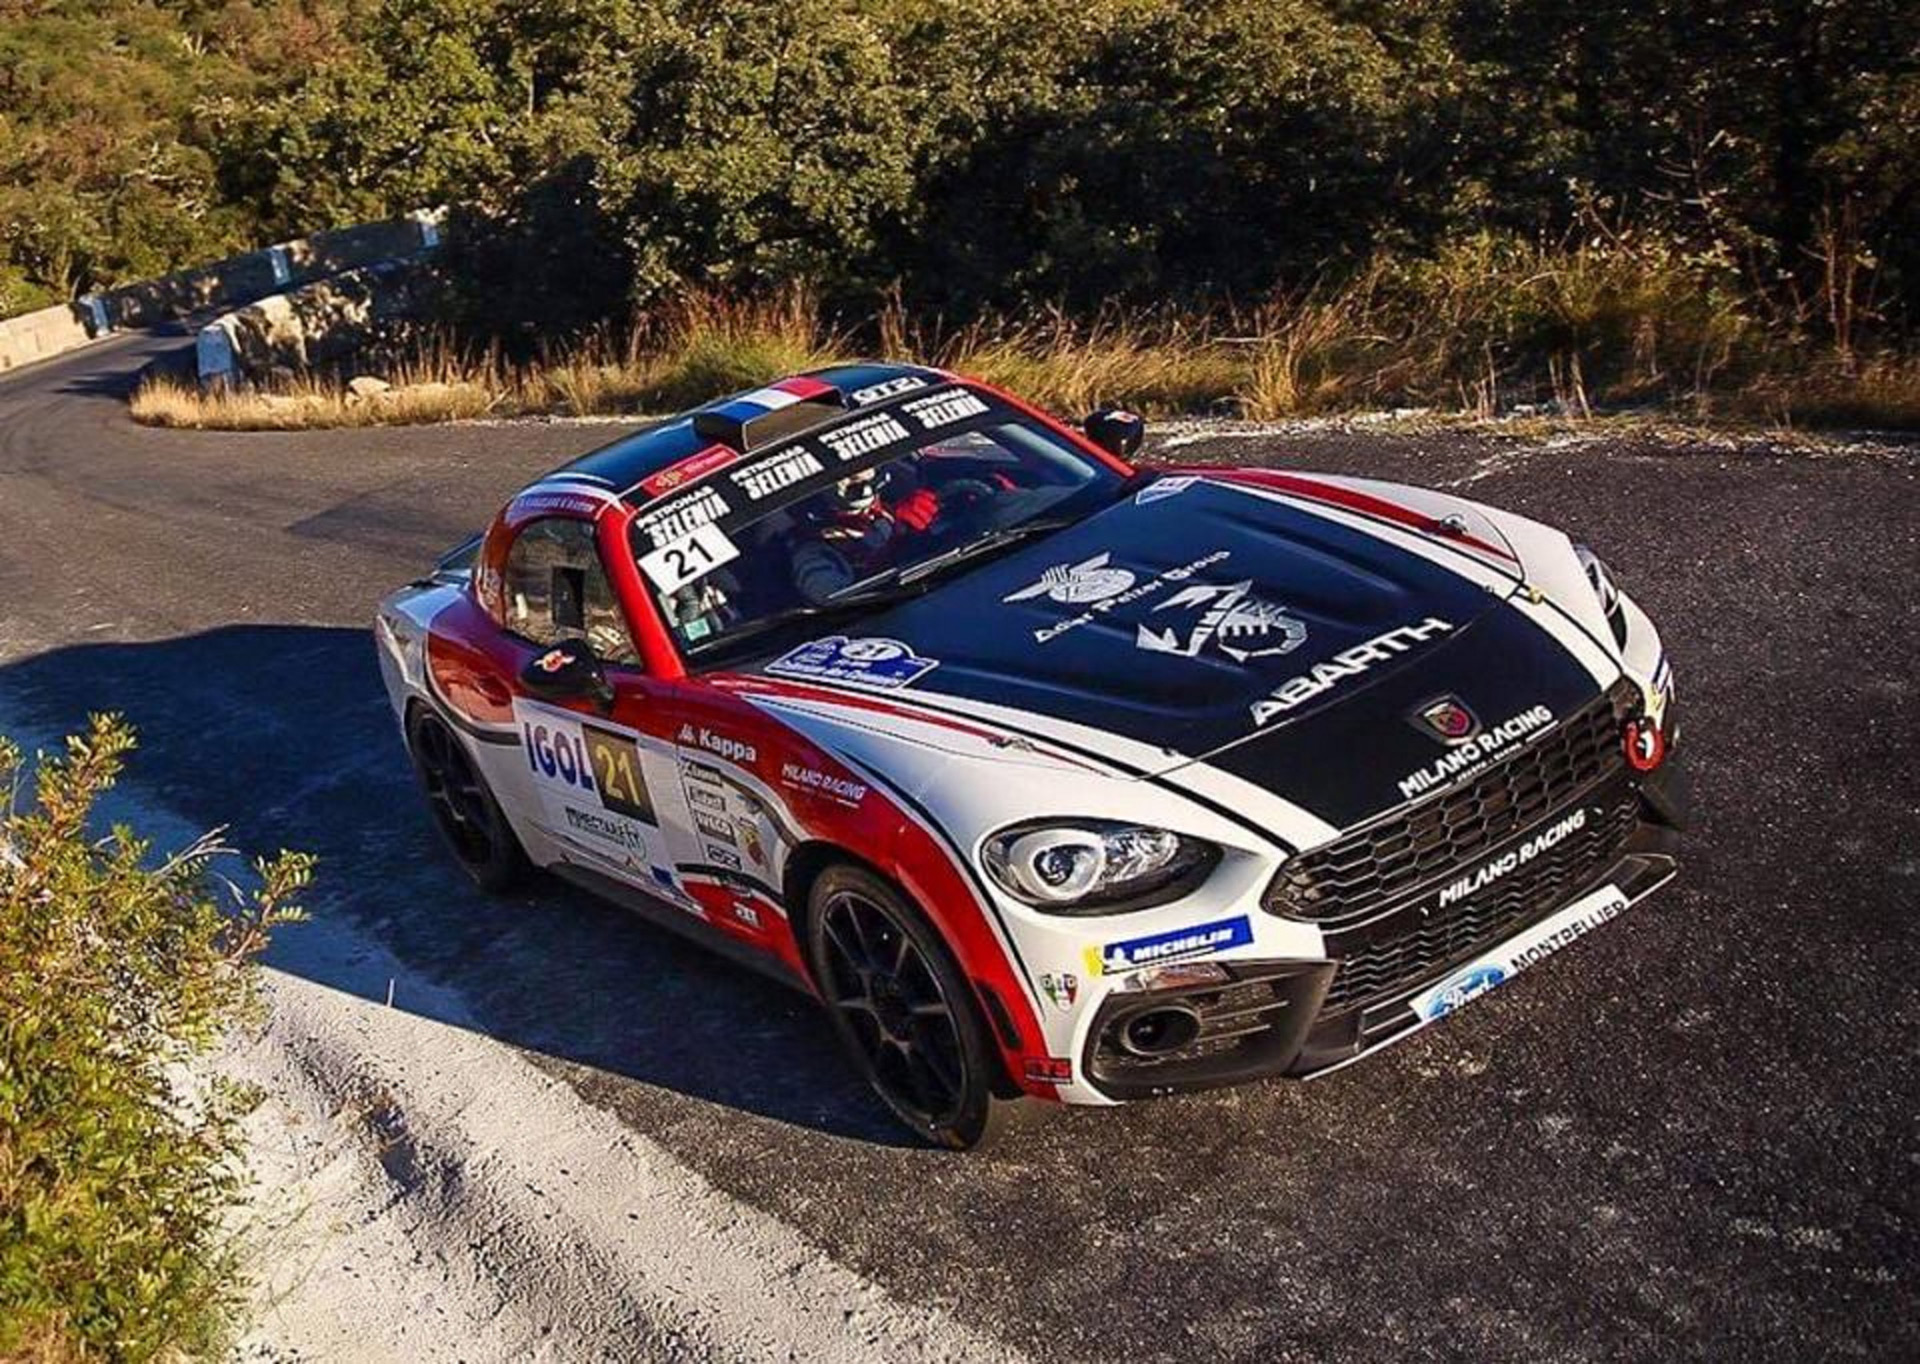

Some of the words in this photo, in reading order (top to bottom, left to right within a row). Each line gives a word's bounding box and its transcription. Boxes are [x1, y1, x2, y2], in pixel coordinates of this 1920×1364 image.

[911, 395, 990, 429] SELENIA
[828, 419, 910, 461] SELENIA
[738, 451, 824, 500] SELENIA
[645, 492, 731, 549] SELENIA
[664, 537, 714, 580] 21
[1250, 617, 1453, 726] ABARTH
[524, 722, 595, 792] IGOL
[699, 729, 757, 763] Kappa
[1398, 742, 1481, 799] MILANO
[1477, 705, 1553, 753] RACING
[595, 744, 641, 807] 21
[821, 775, 866, 801] RACING
[1439, 851, 1518, 908] MILANO
[1518, 808, 1586, 865] RACING
[1133, 927, 1234, 962] MICHELIN
